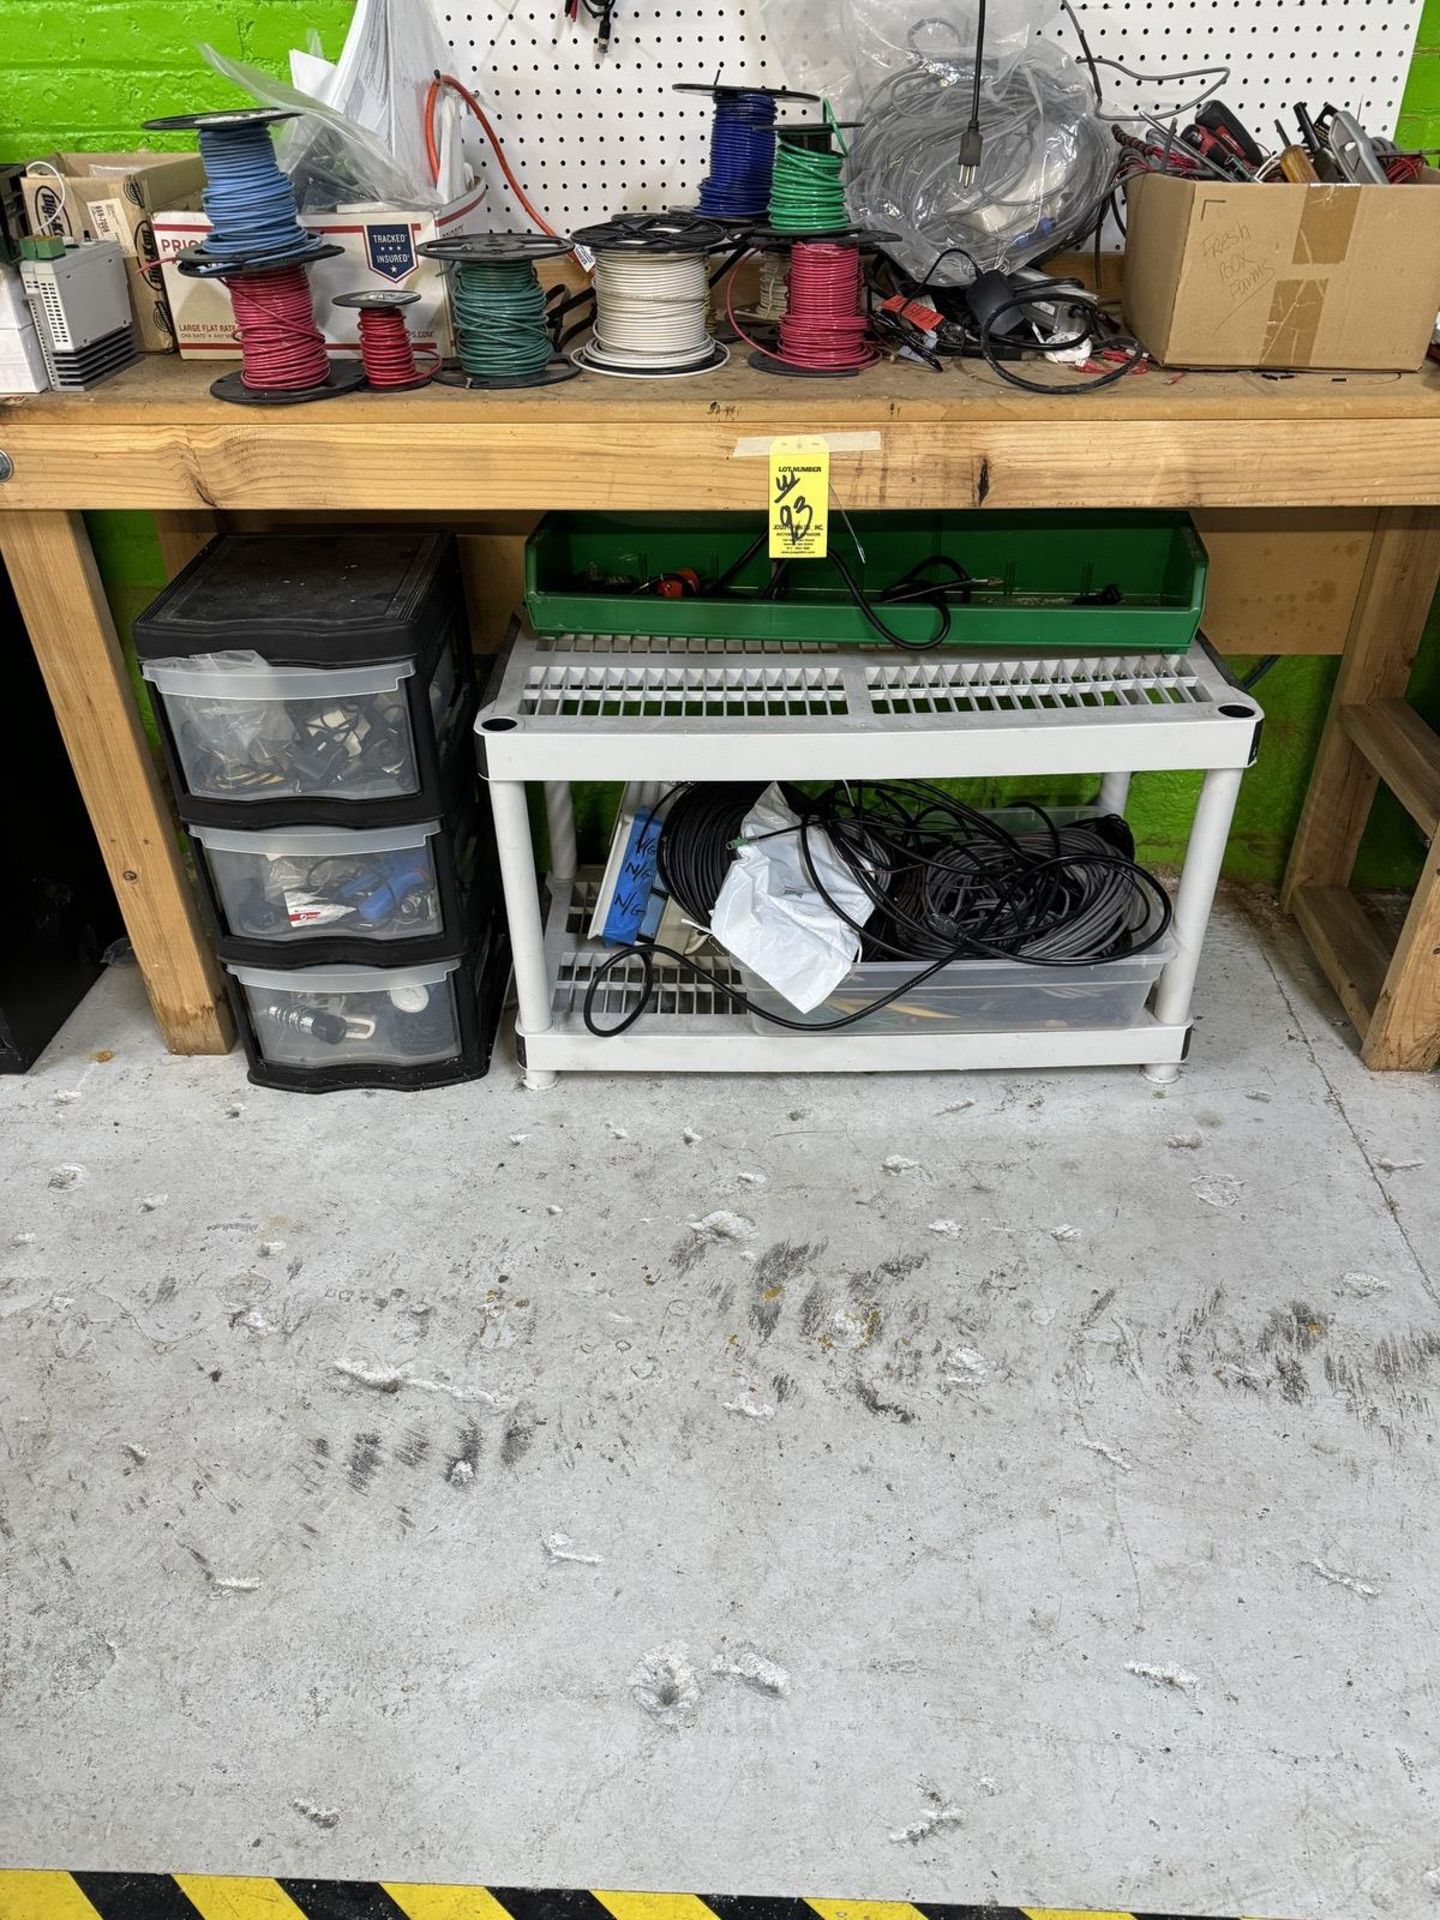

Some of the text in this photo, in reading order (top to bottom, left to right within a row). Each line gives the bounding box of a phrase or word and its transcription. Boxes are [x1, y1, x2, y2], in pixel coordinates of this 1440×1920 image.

[373, 234, 406, 243] TRACKED
[161, 239, 204, 252] PRIO
[377, 254, 408, 264] INSURED
[780, 495, 813, 546] 93
[614, 890, 646, 916] N/G
